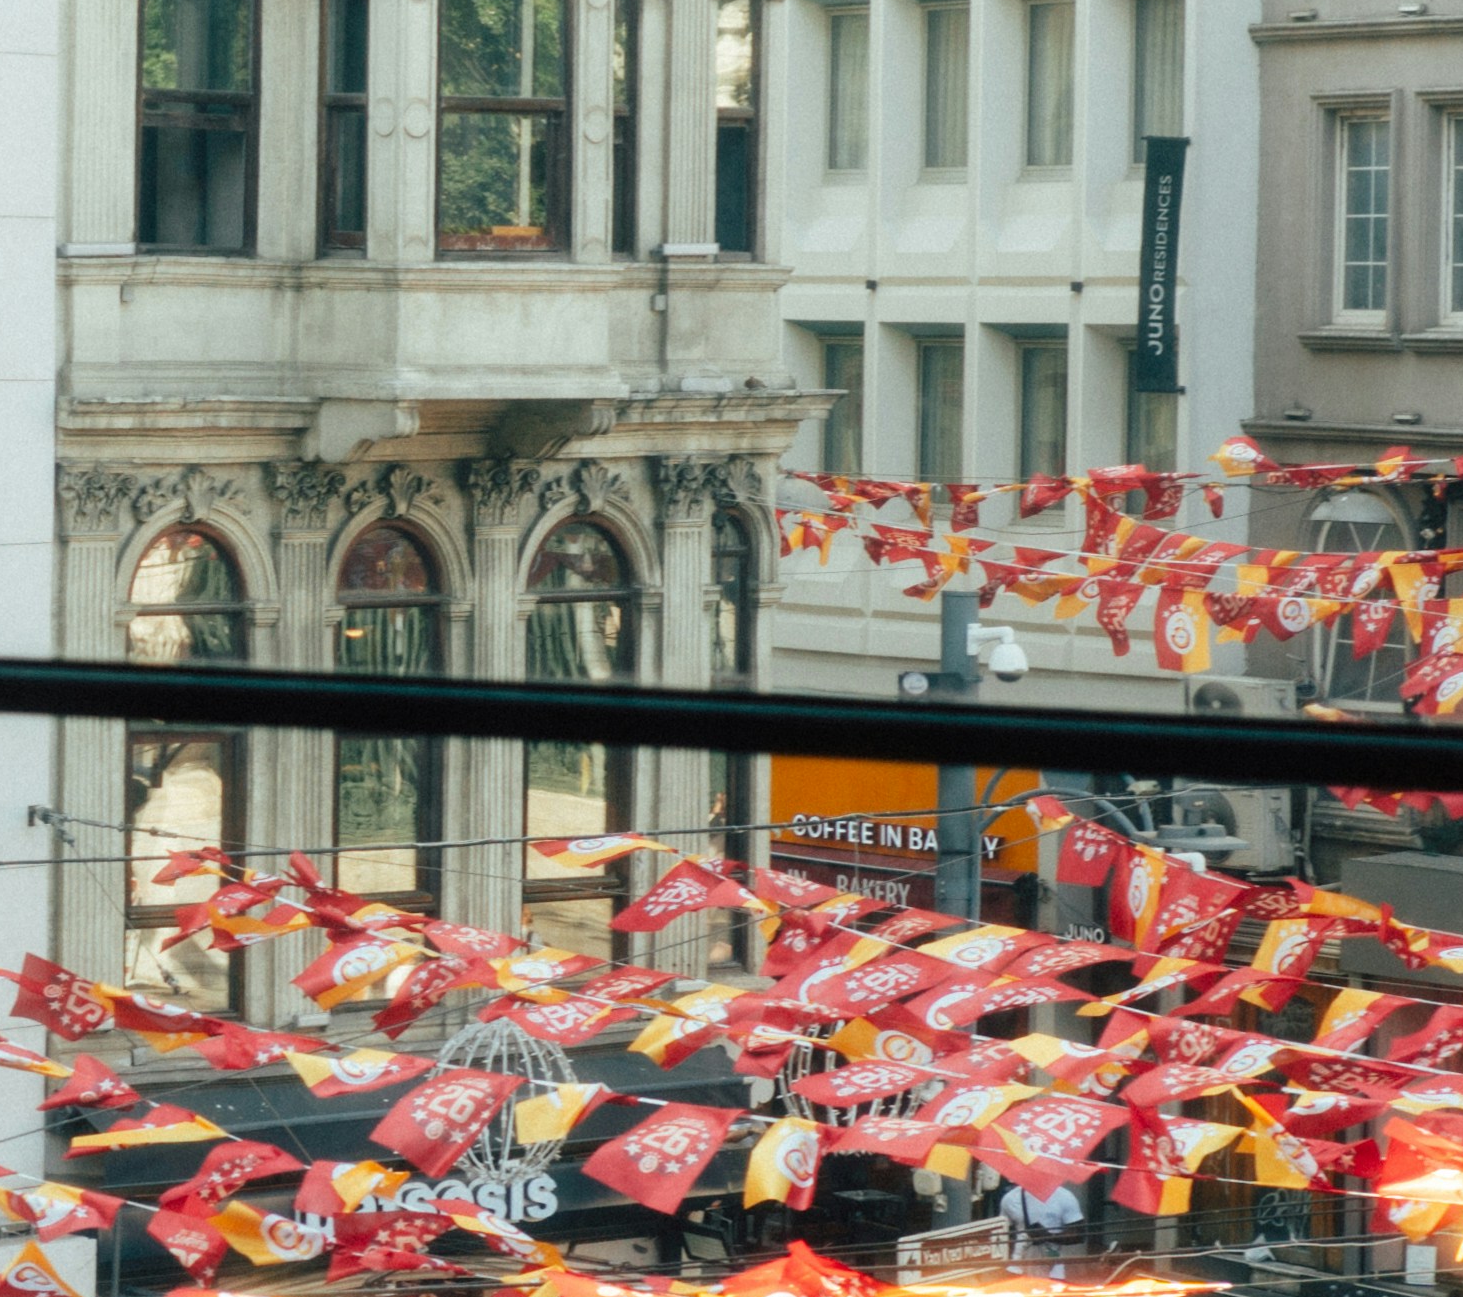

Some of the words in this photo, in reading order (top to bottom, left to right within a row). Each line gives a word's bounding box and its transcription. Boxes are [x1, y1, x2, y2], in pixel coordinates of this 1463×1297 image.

[1147, 284, 1166, 356] JUNO
[792, 814, 874, 845] COFFEE
[880, 824, 903, 849] IN
[909, 828, 1002, 860] BAY
[1064, 924, 1105, 945] JUNO
[431, 1085, 475, 1123] 26
[644, 1120, 690, 1152] 26
